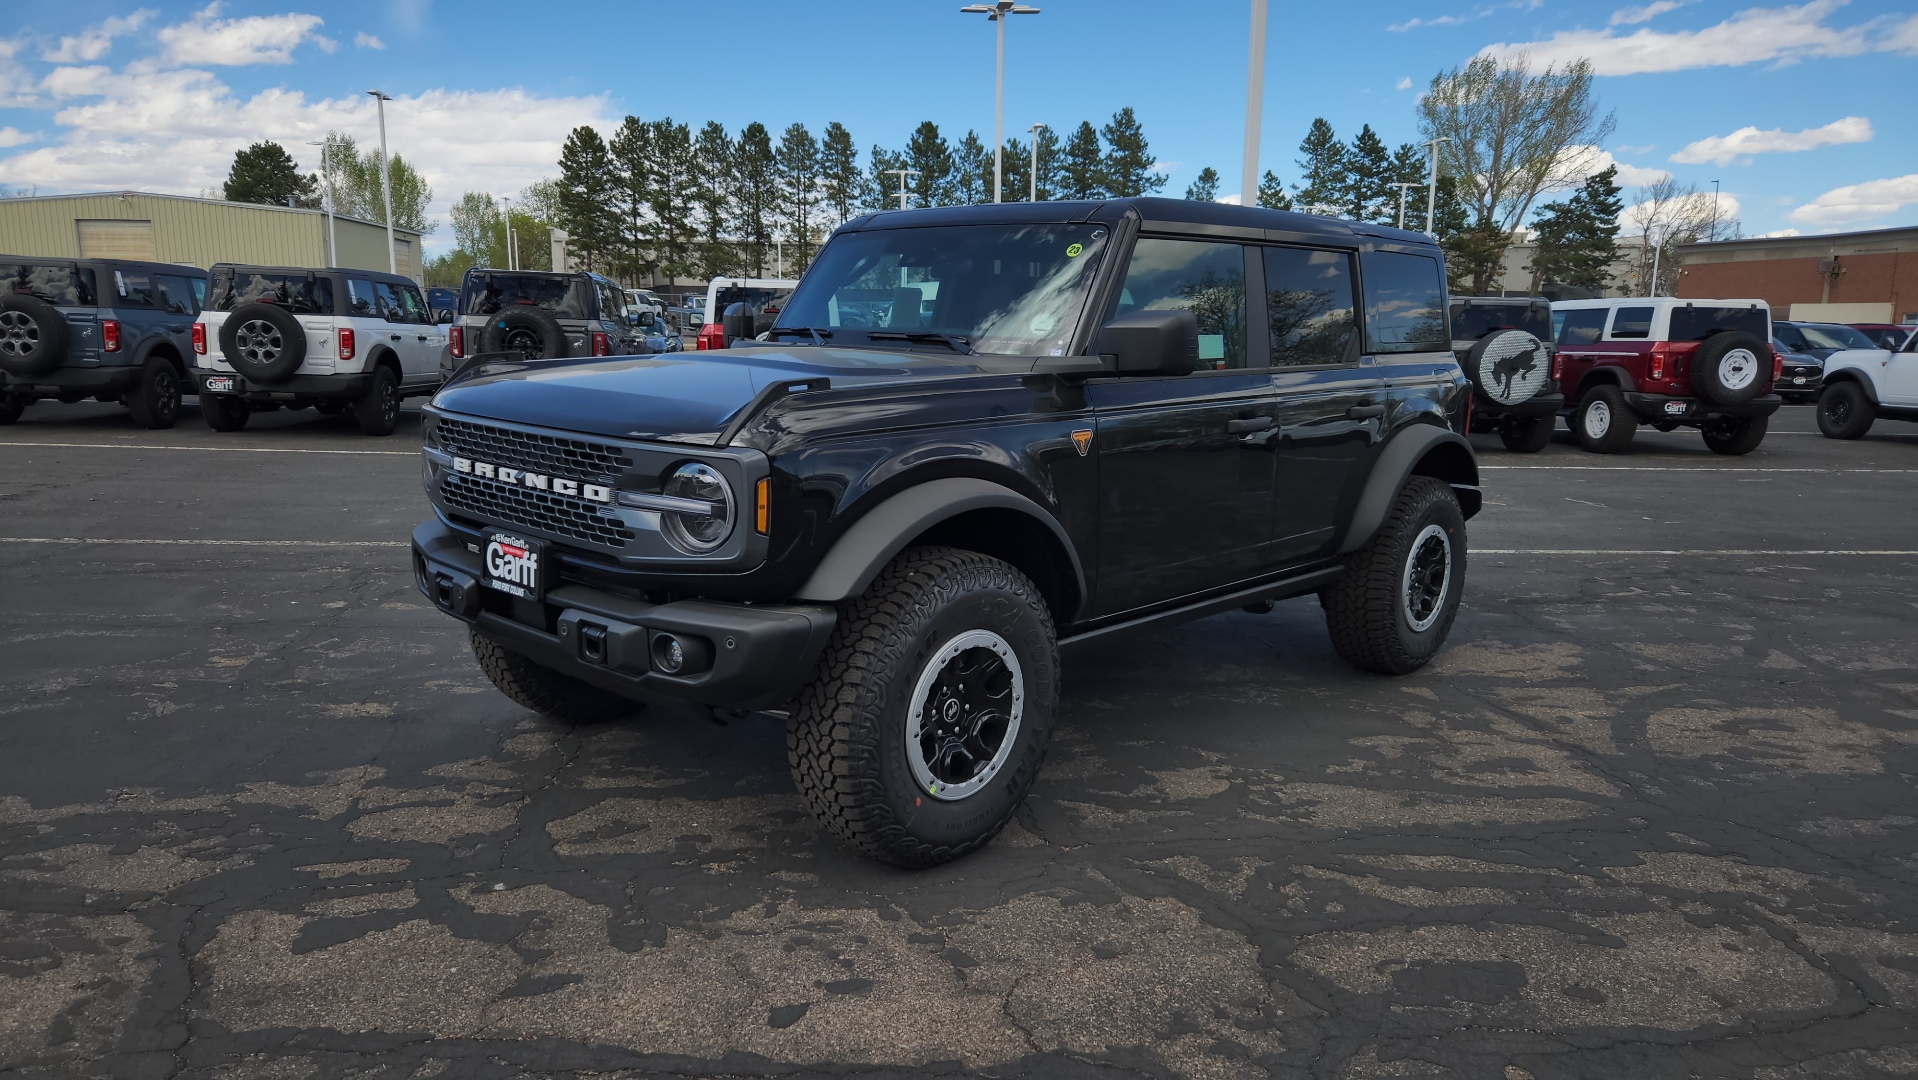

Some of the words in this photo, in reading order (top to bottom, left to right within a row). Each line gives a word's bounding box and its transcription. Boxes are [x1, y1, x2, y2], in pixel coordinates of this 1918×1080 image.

[1068, 245, 1081, 255] 23
[206, 378, 234, 390] Garff
[453, 456, 611, 503] BRONCO
[486, 541, 538, 588] Garff
